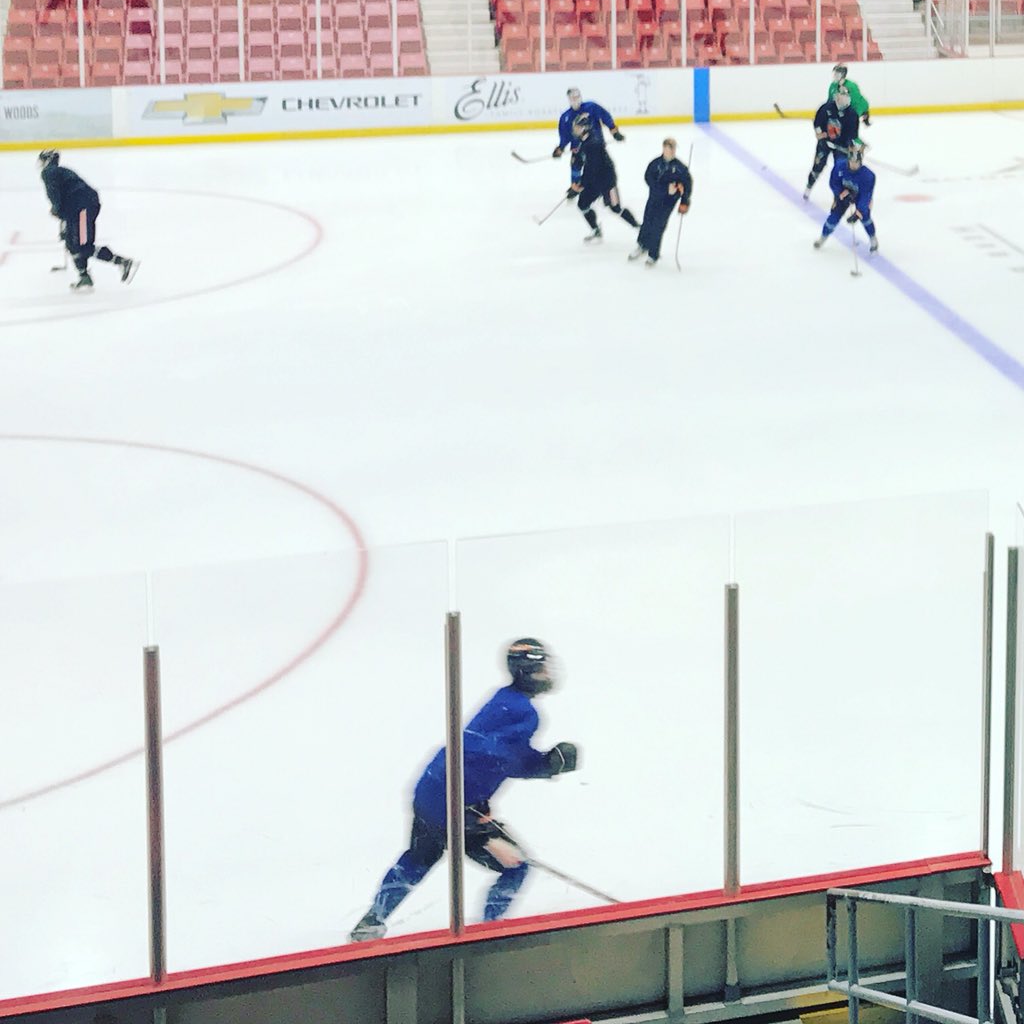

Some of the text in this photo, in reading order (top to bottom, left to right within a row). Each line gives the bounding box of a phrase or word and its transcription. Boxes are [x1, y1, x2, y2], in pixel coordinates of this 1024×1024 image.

[281, 93, 423, 113] CHEVROLET
[454, 76, 521, 121] Ellis
[3, 104, 39, 120] WOODS
